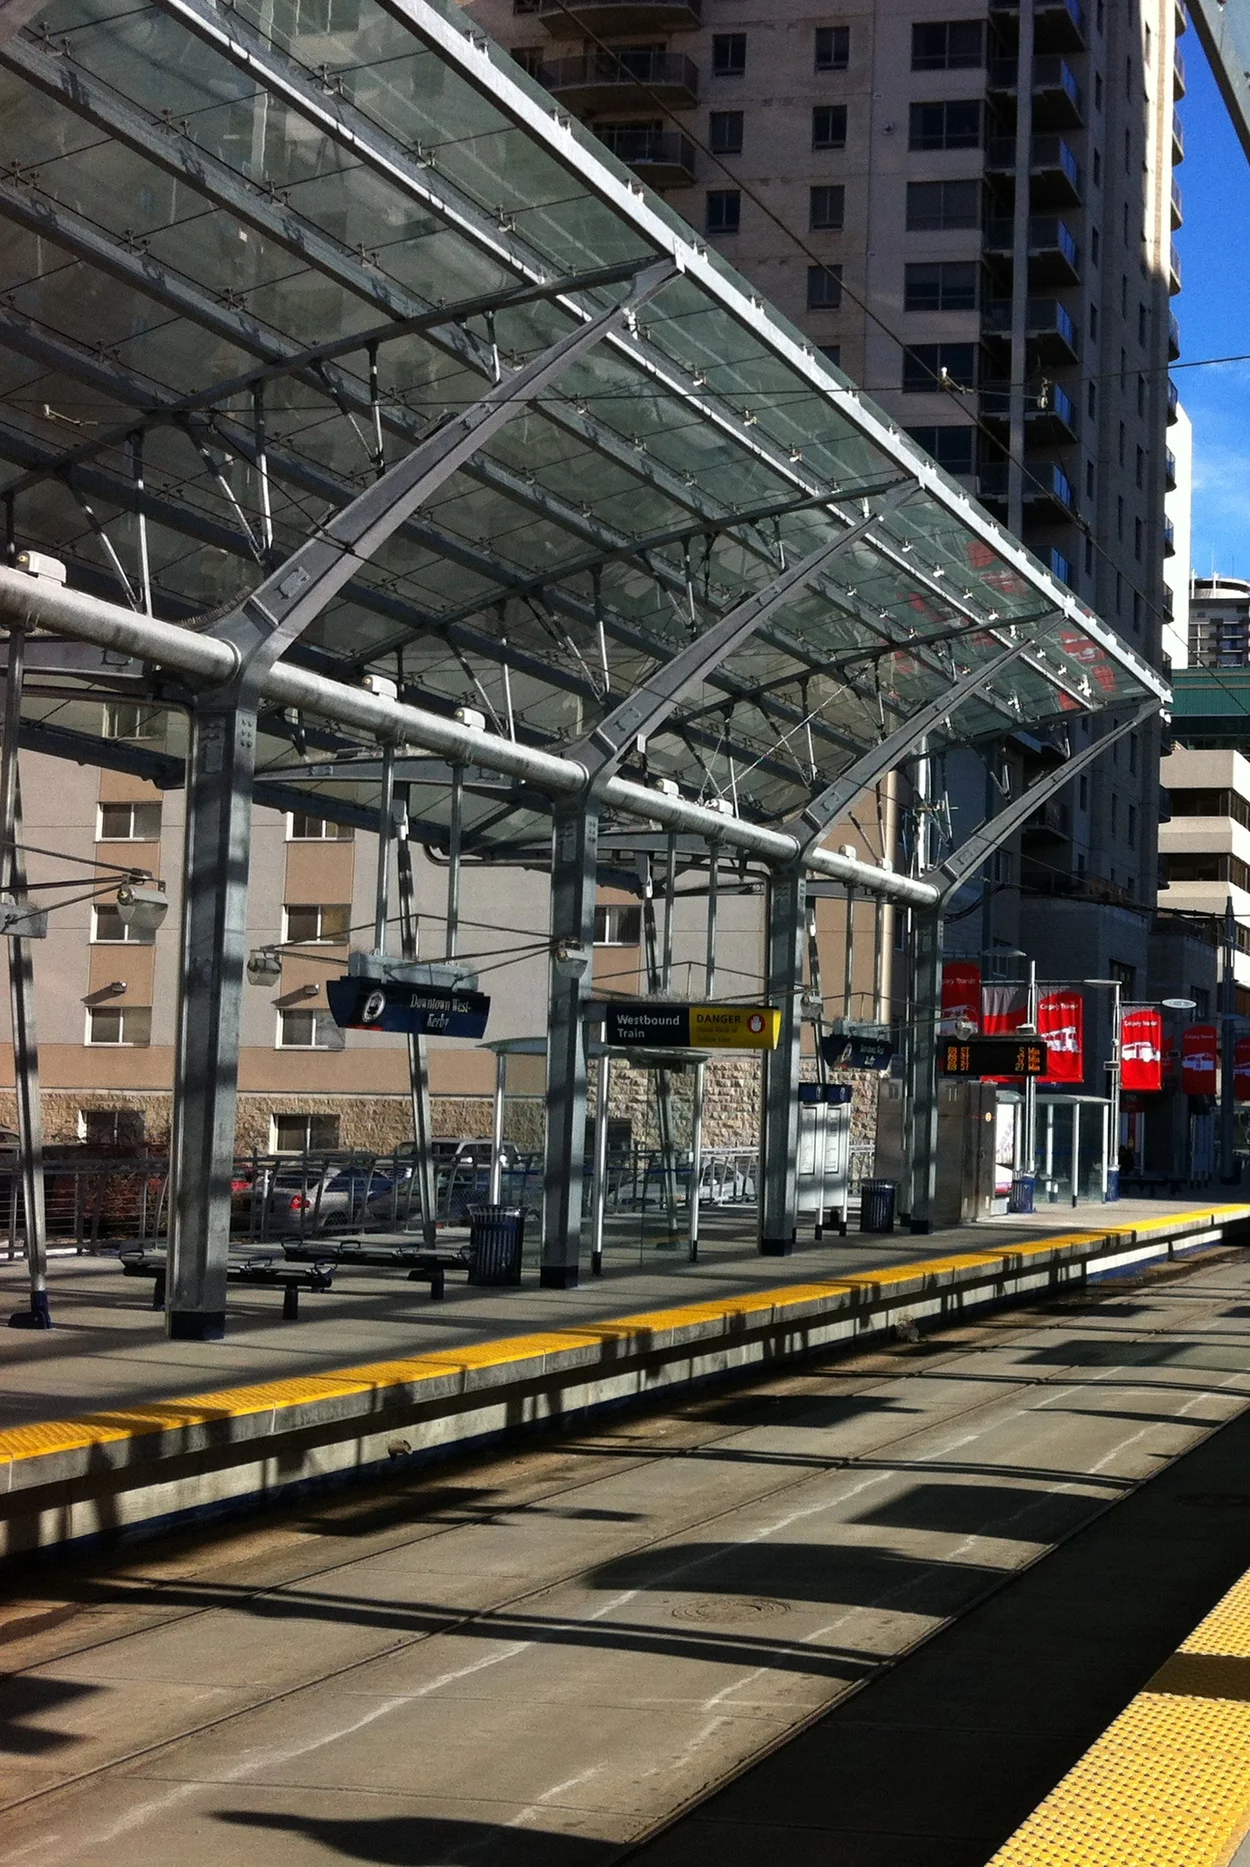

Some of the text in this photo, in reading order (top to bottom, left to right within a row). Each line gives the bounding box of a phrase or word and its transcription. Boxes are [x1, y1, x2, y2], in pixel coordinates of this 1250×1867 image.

[617, 1014, 680, 1026] Westbound
[697, 1014, 741, 1024] DANGER
[617, 1028, 645, 1039] Train
